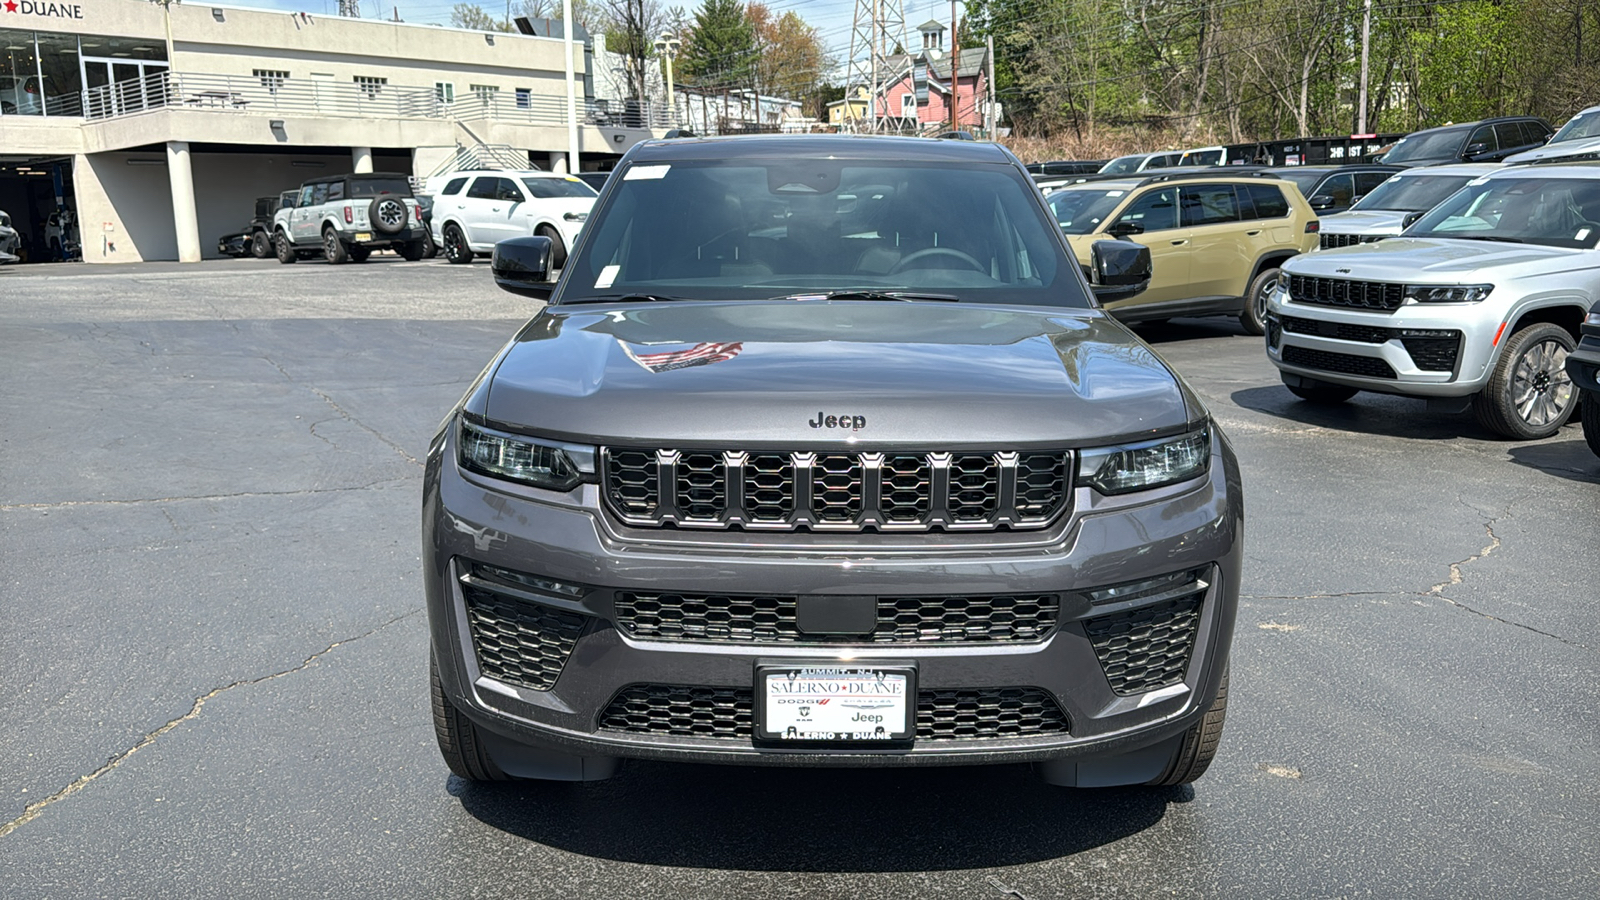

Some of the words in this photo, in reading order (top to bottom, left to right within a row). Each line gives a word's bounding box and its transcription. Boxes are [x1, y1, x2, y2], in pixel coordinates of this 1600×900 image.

[21, 1, 83, 19] DUANE
[809, 411, 866, 432] Jeep
[771, 682, 840, 694] SALERNO
[849, 682, 902, 695] DUANE
[851, 712, 883, 724] Jeep
[781, 731, 835, 740] SALERNO
[853, 731, 892, 740] DUANE
